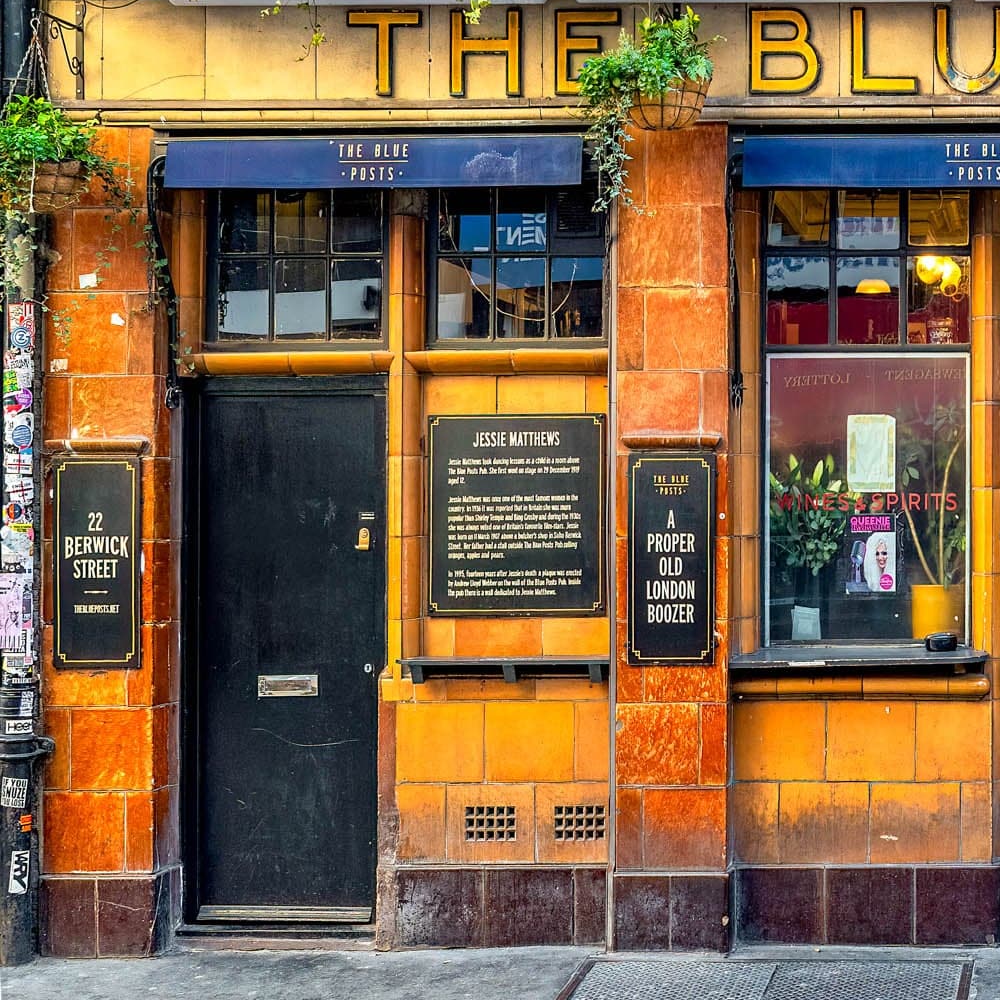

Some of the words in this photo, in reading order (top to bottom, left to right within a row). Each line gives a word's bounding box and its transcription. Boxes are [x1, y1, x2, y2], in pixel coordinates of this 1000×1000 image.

[346, 7, 623, 98] THE
[339, 143, 363, 158] THE
[374, 143, 409, 158] BLUE
[945, 143, 970, 158] THE
[473, 431, 506, 447] JESSIE
[509, 431, 560, 447] MATTHEWS
[653, 475, 666, 483] THE
[671, 475, 689, 483] BLUE
[775, 493, 850, 511] WINES
[870, 492, 958, 511] SPIRITS
[87, 512, 103, 532] 22
[666, 510, 676, 529] A
[850, 516, 891, 525] QUEENIE
[64, 535, 129, 560] BERWICK
[647, 533, 695, 553] PROPER
[72, 558, 118, 579] STREET
[658, 556, 683, 577] OLD
[646, 580, 696, 600] LONDON
[647, 604, 695, 624] BOOZER
[11, 779, 27, 787] YOU
